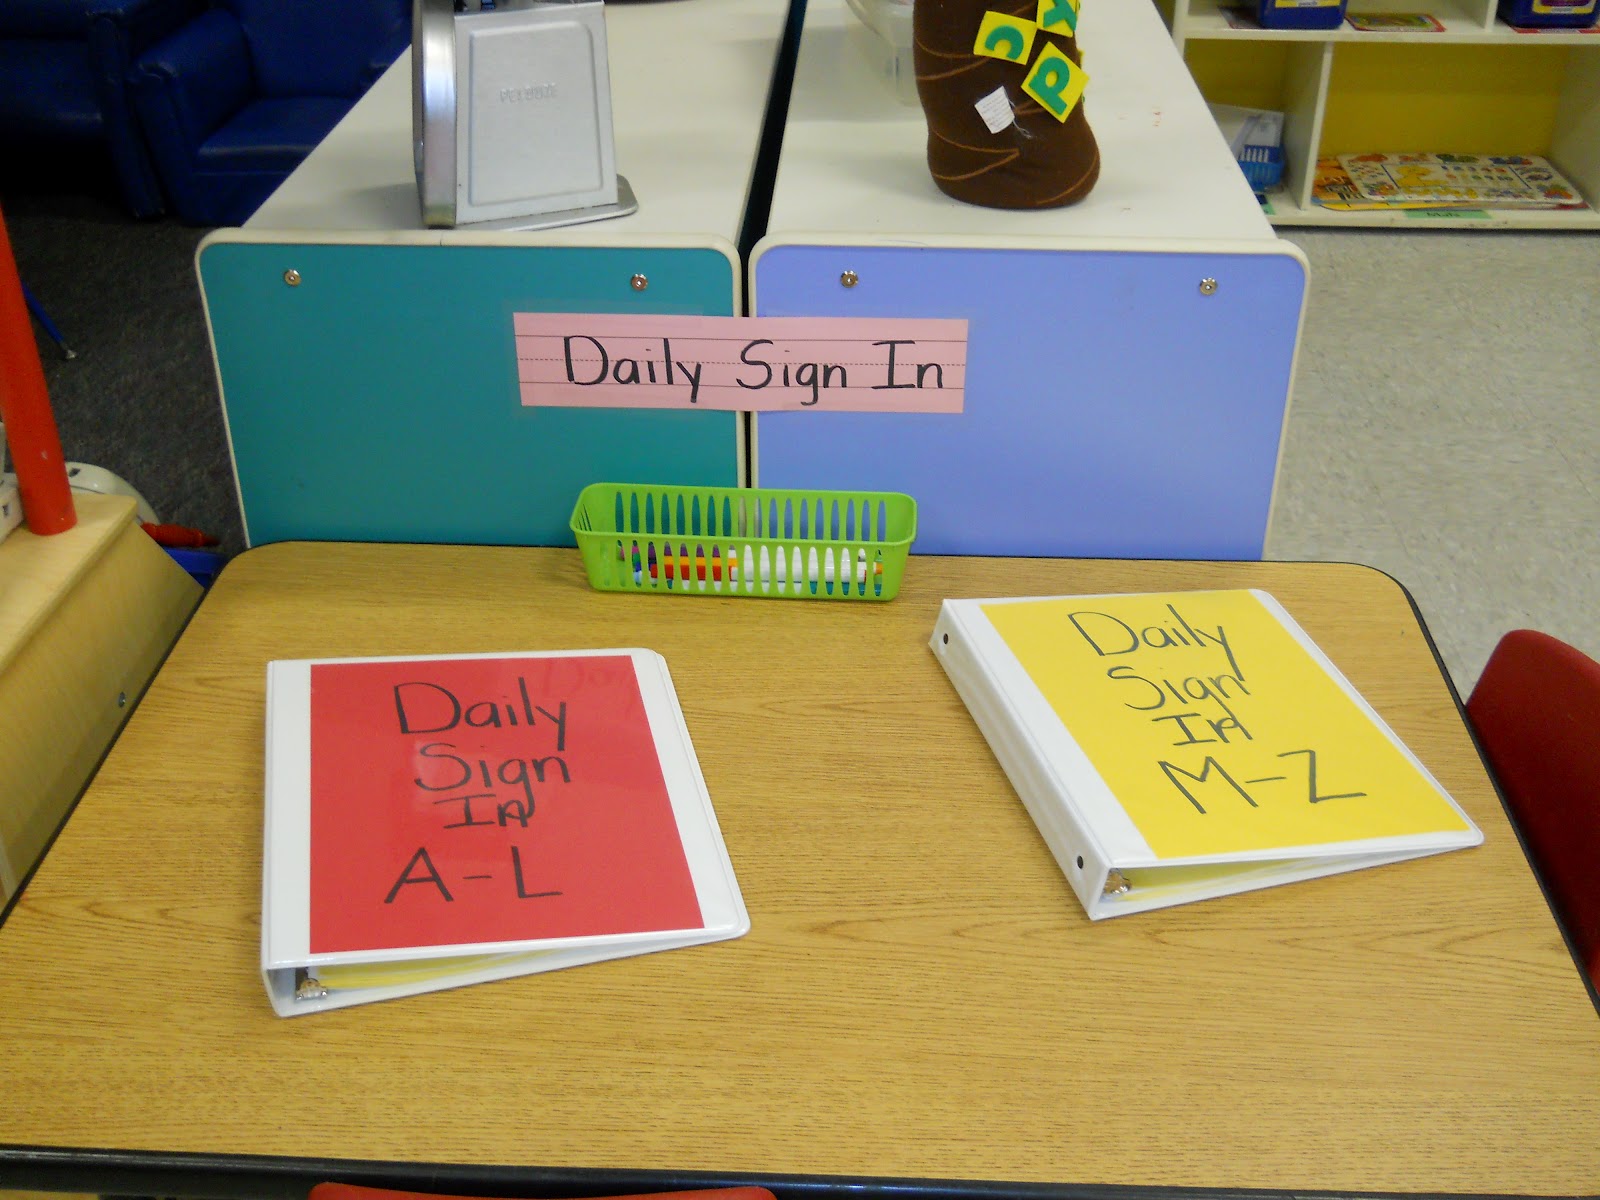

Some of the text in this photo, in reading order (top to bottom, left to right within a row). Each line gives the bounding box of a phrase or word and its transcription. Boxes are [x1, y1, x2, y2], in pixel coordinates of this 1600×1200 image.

[563, 335, 944, 406] Daily Sign In
[1067, 603, 1245, 682] Daily
[394, 677, 567, 751] Daily
[1106, 665, 1251, 729] Sign
[1151, 712, 1253, 746] In
[414, 742, 571, 820] Sign
[432, 794, 529, 828] In
